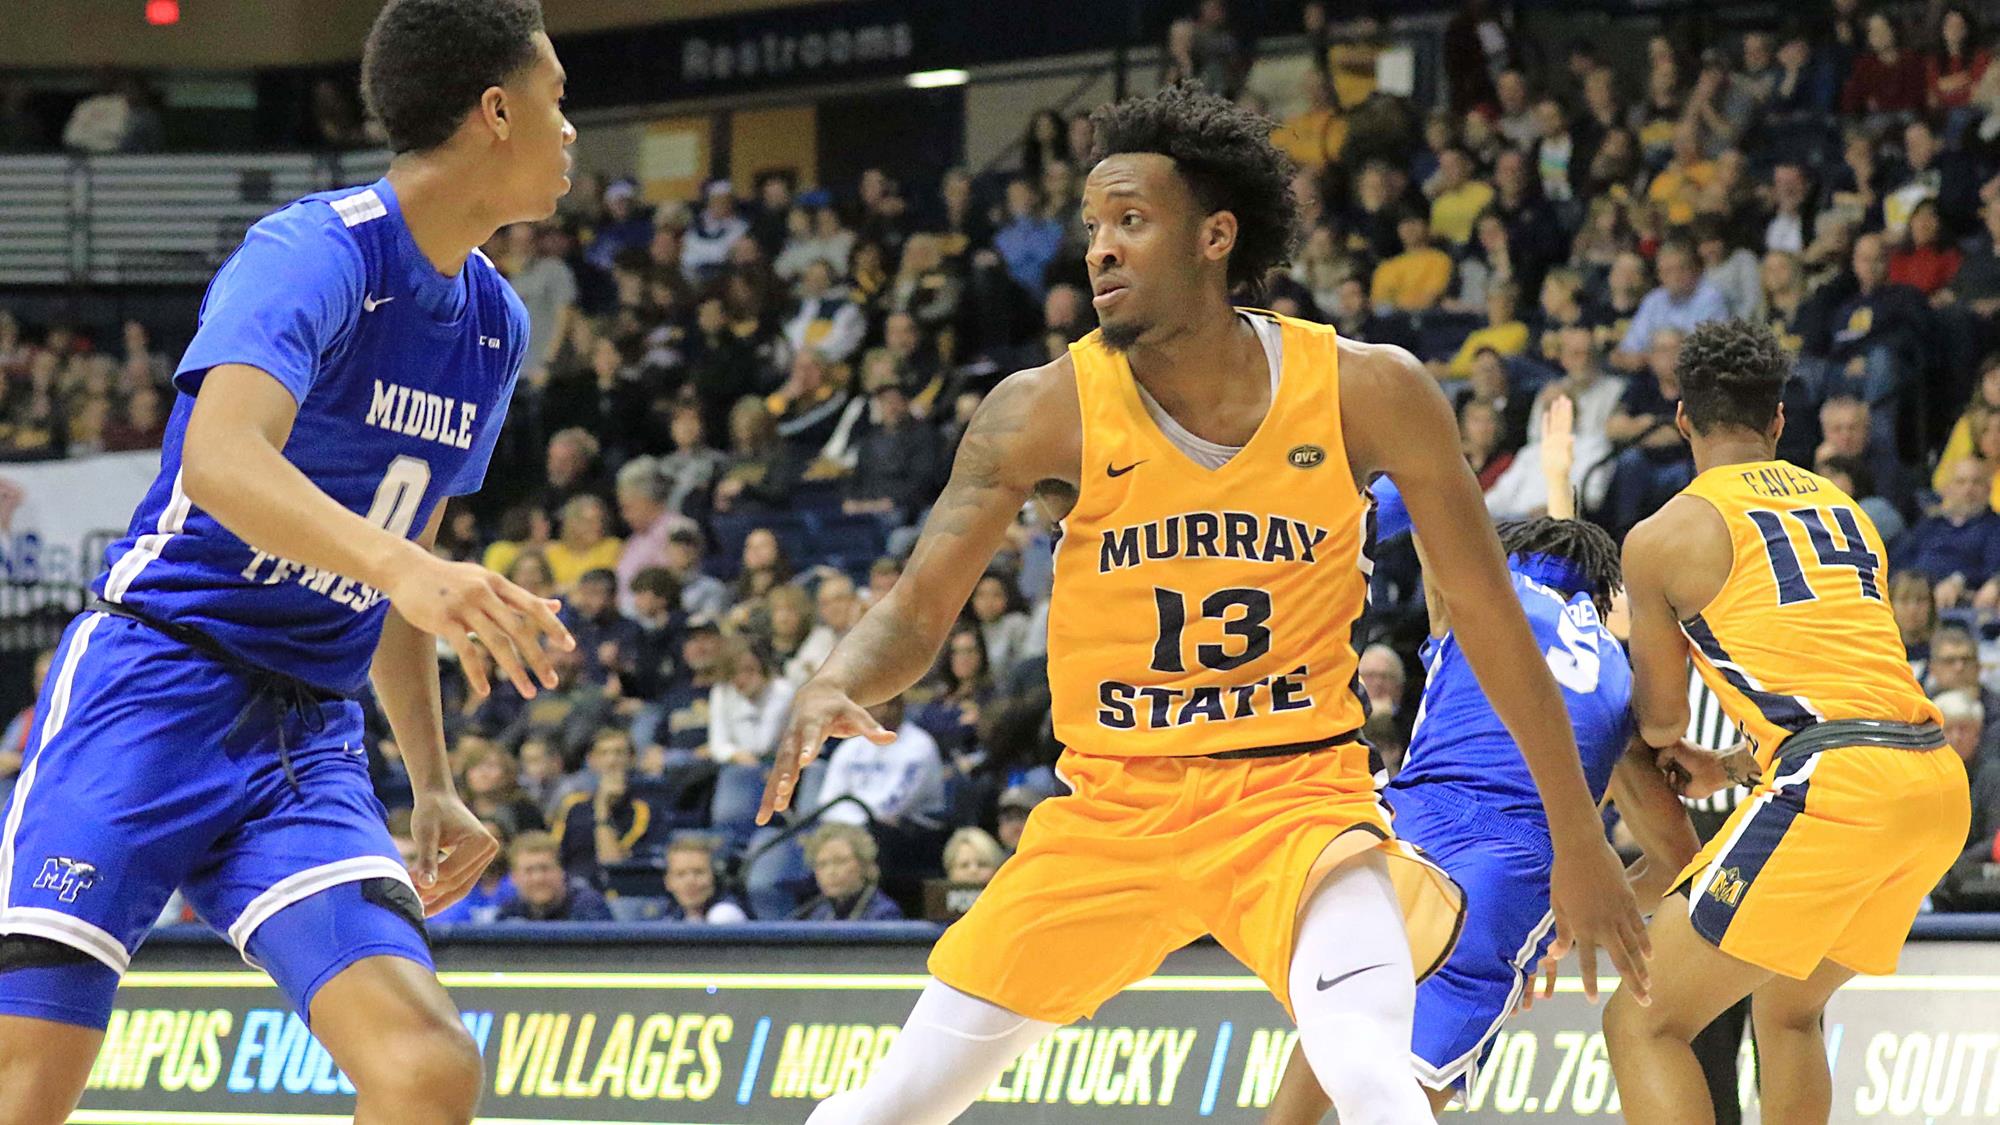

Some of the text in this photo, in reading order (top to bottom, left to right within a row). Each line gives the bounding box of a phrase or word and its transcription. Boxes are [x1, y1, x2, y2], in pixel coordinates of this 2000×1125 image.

[365, 378, 478, 450] MIDDLE
[366, 454, 431, 539] 0
[1741, 467, 1819, 497] EAVES
[1099, 511, 1328, 575] MURRAY
[1745, 506, 1882, 607] 14
[1150, 585, 1273, 673] 13
[1098, 665, 1315, 730] STATE
[85, 1009, 233, 1091] MPUS
[495, 1012, 733, 1101] VILLAGES
[770, 1023, 904, 1100] MURR
